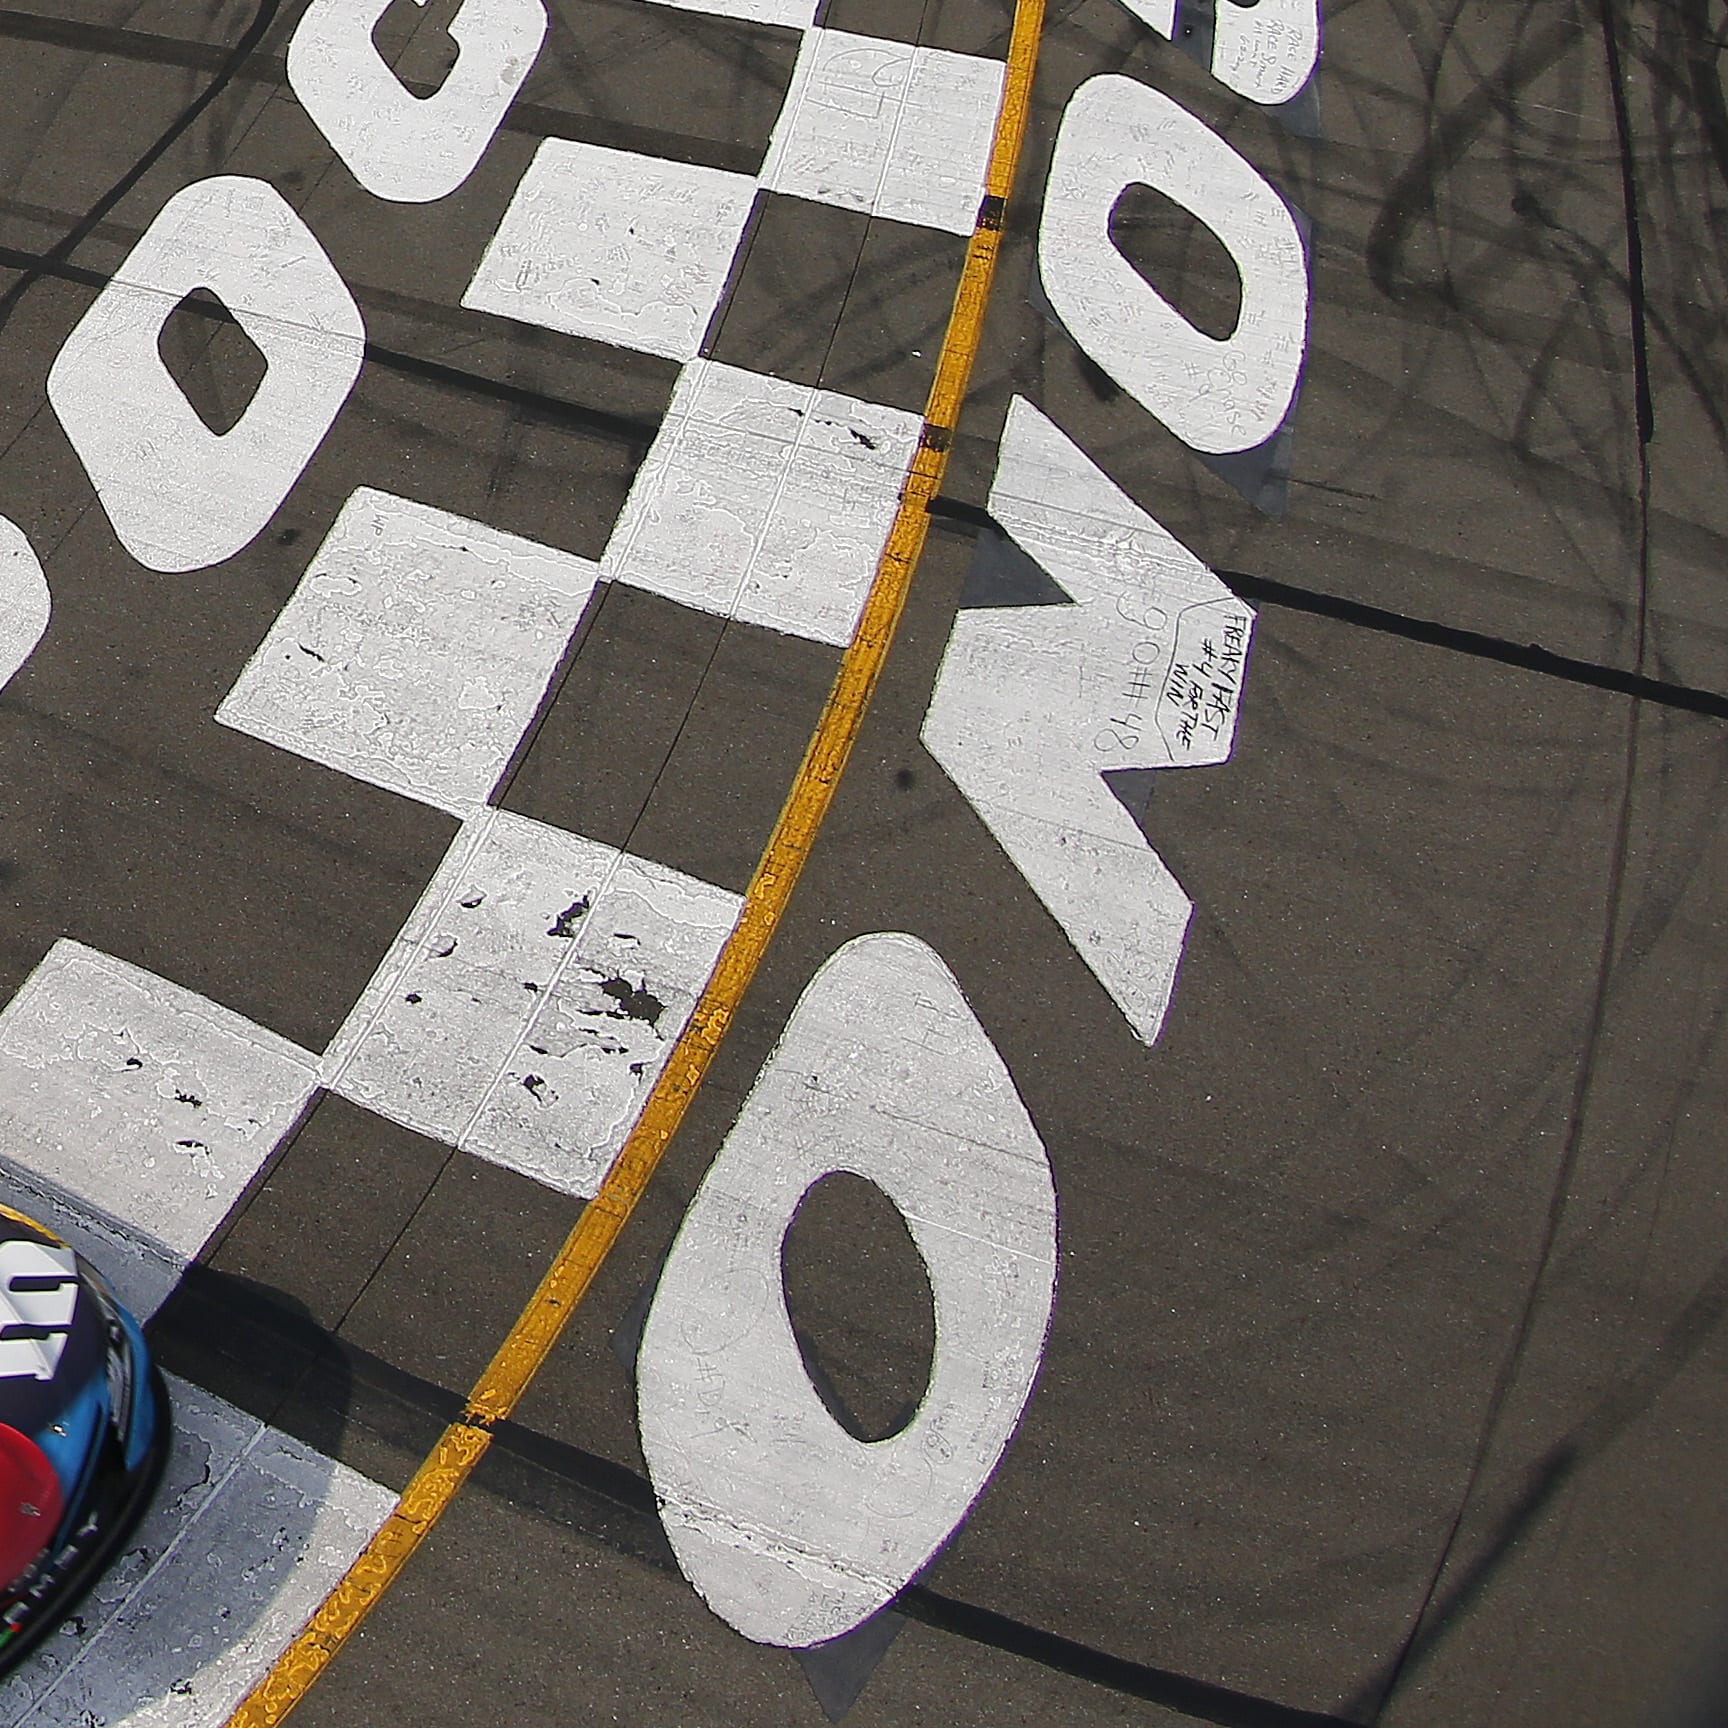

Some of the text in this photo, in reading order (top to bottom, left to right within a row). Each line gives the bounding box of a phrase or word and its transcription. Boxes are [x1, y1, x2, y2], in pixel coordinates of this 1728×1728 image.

[1166, 663, 1190, 706] WIN
[1201, 615, 1247, 741] FREAKY FAST
